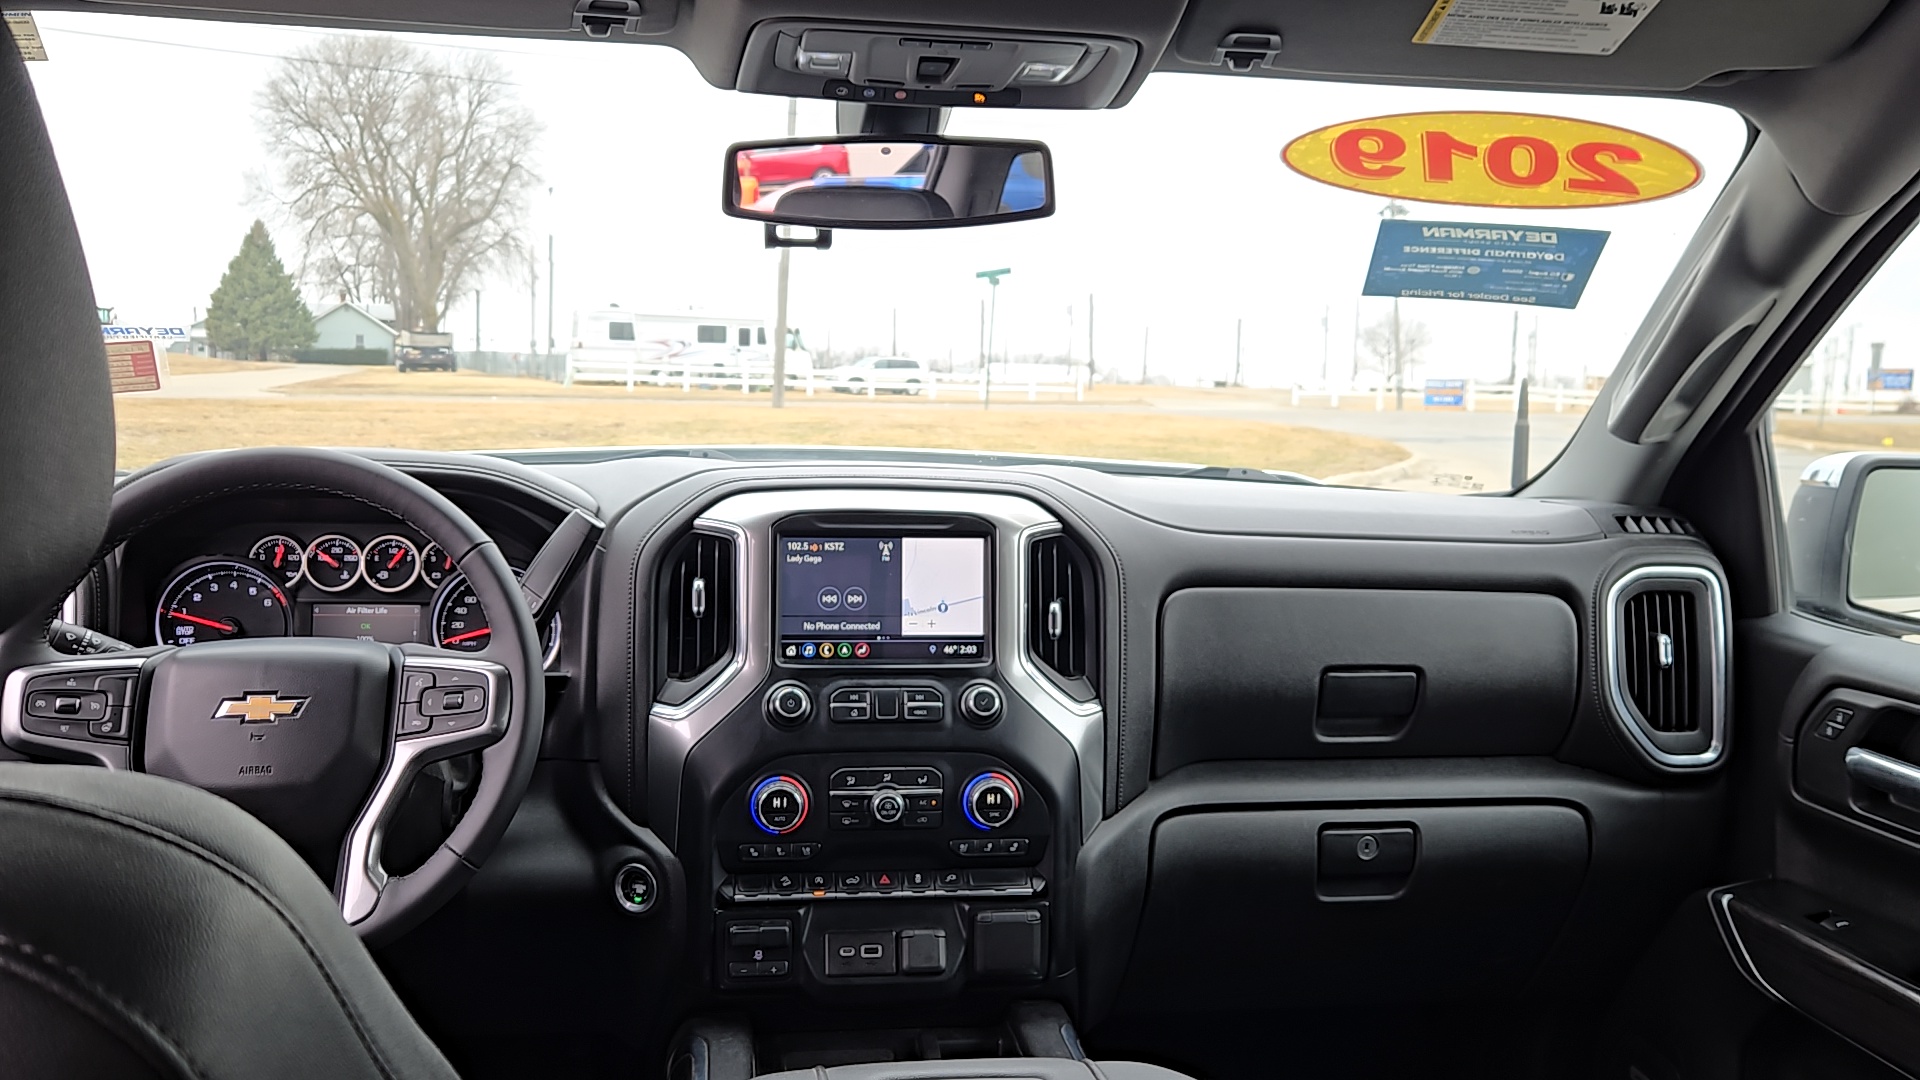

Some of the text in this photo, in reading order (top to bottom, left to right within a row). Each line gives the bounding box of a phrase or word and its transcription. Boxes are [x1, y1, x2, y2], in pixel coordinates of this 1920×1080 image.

[787, 542, 809, 551] 102.5
[824, 542, 845, 551] KSTZ
[786, 555, 822, 564] Lady Gaga
[209, 583, 219, 592] 3
[229, 581, 238, 590] 4
[248, 586, 258, 596] 5
[192, 593, 202, 602] 2
[464, 596, 477, 604] 60
[263, 598, 272, 607] 6
[454, 606, 468, 615] 40
[451, 621, 465, 629] 20
[803, 622, 880, 631] No Phone Connected
[178, 637, 196, 645] OFF
[959, 645, 977, 655] 2:03
[239, 765, 273, 776] AIRBAG
